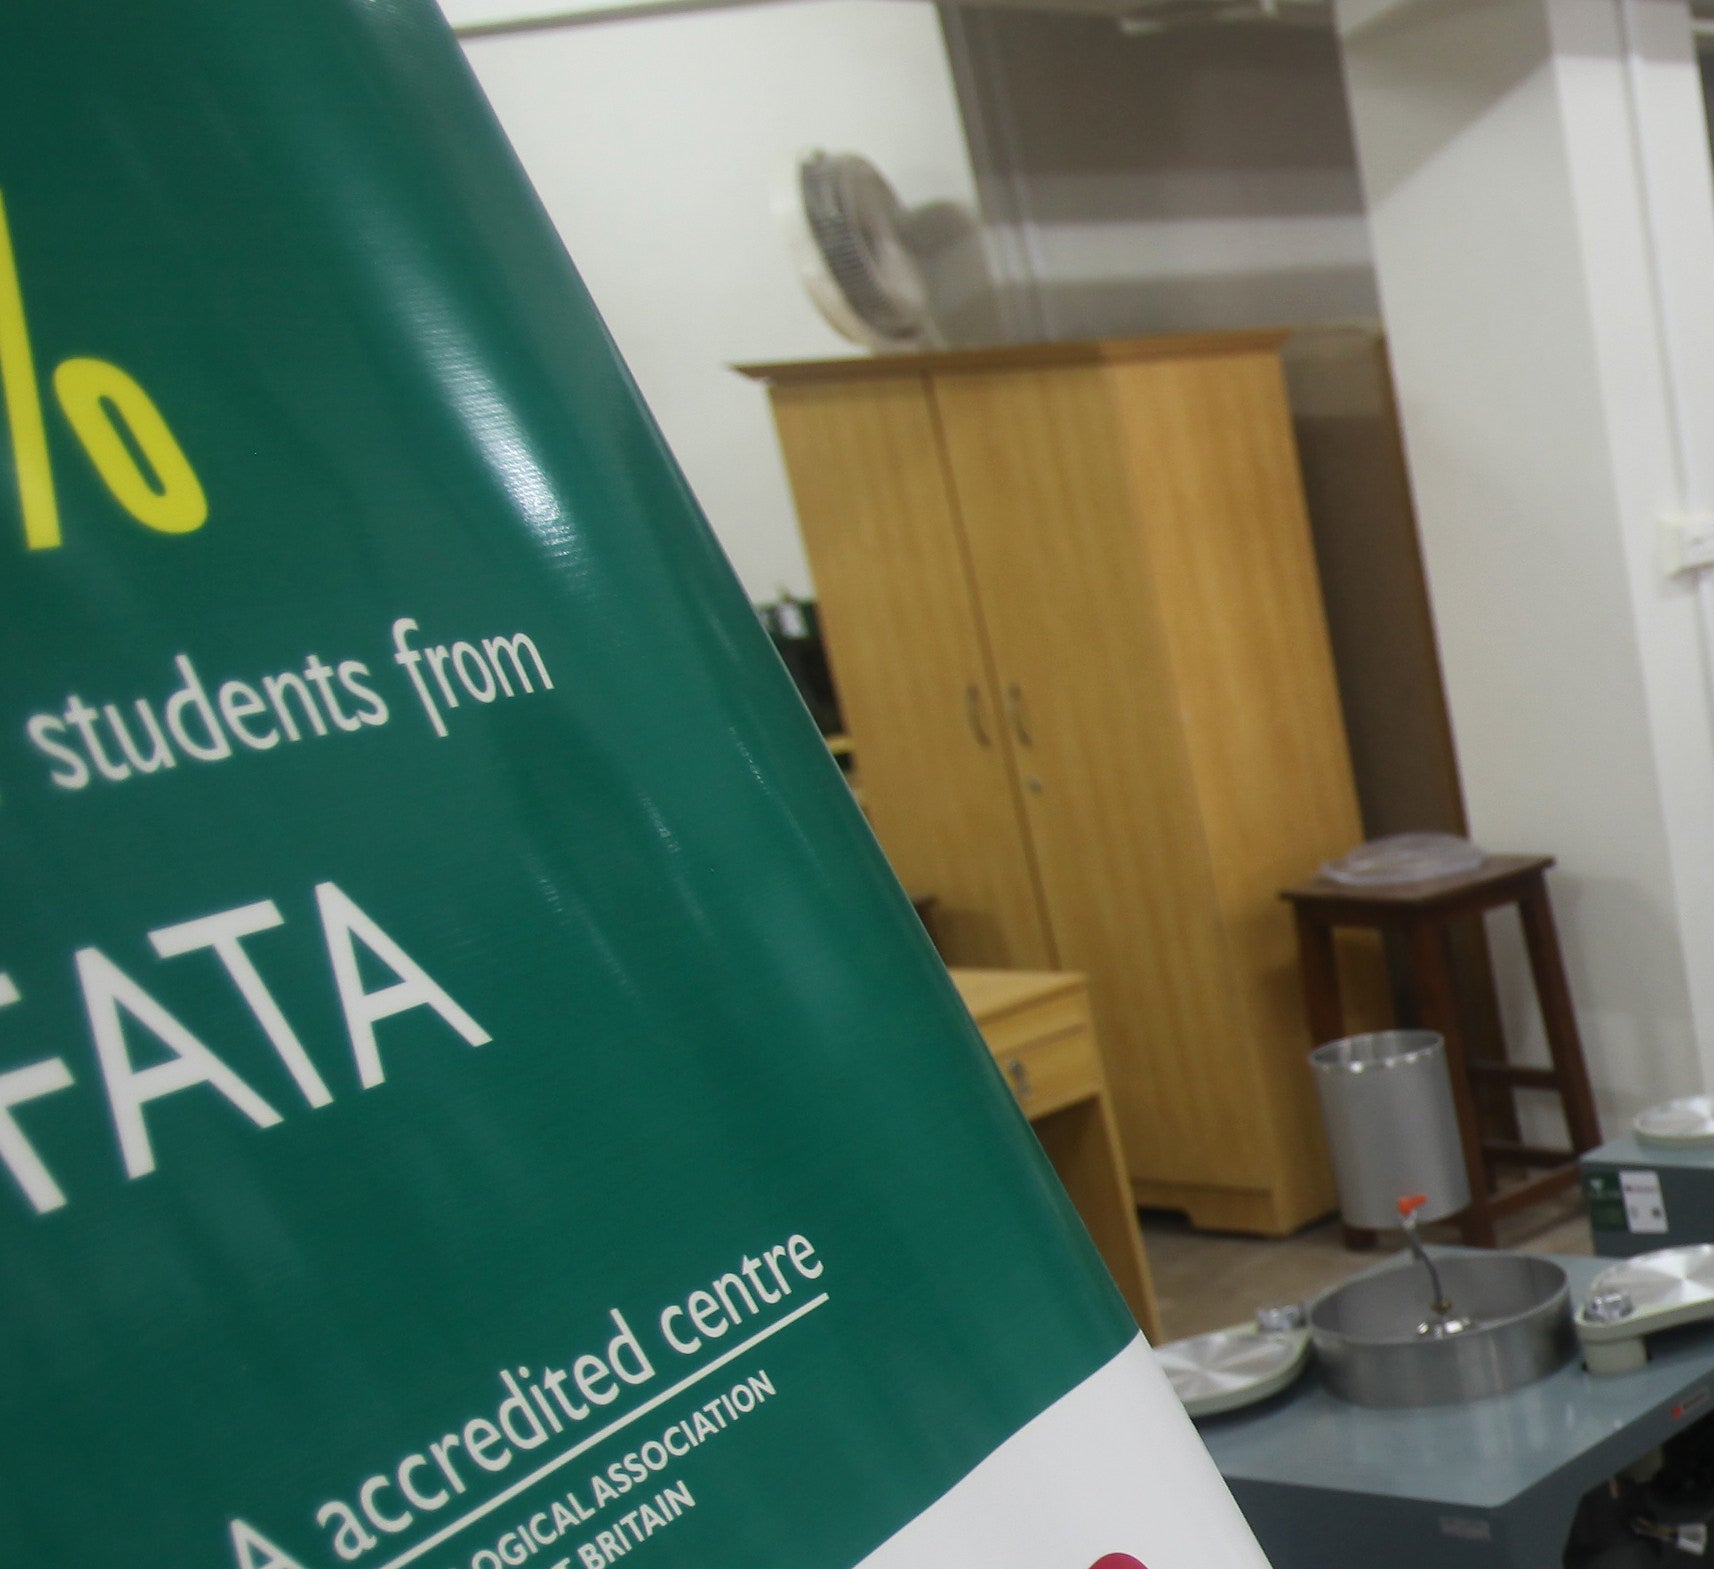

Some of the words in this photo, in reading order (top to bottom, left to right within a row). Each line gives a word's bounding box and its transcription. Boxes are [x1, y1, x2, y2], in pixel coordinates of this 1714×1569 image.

[27, 654, 388, 791] students
[395, 619, 555, 738] from
[316, 1309, 655, 1560] accredited
[661, 1234, 824, 1355] centre
[589, 1369, 777, 1509] ASSOCIATION
